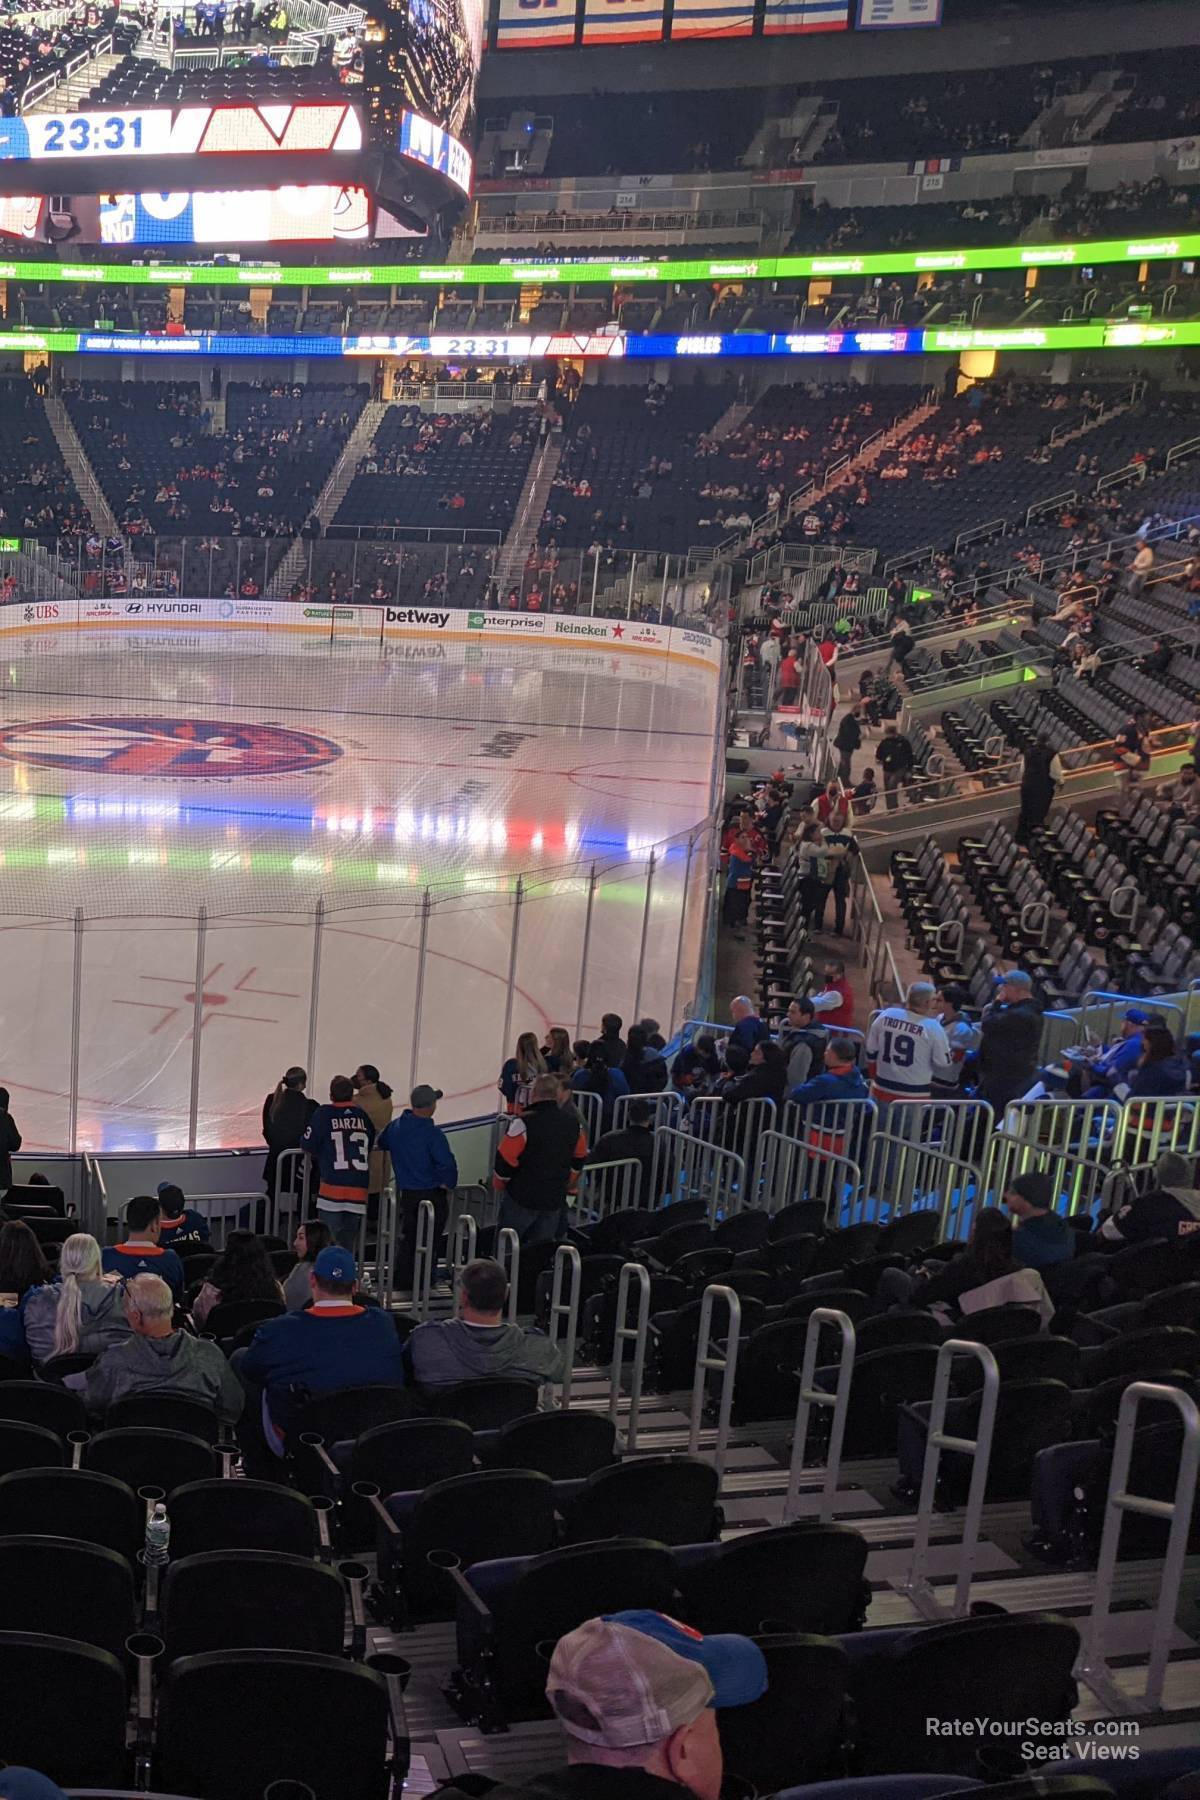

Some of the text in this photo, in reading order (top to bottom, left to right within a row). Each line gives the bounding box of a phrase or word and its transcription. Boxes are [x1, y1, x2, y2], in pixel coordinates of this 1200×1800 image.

[44, 116, 142, 151] 23:31
[447, 339, 509, 354] 23:31
[35, 604, 59, 619] UBS
[147, 603, 201, 613] HYUNDAI
[386, 608, 450, 628] betway
[473, 614, 543, 628] enterprise
[555, 622, 607, 637] Heineken
[883, 1015, 925, 1037] TROTTIER
[881, 1030, 916, 1068] 19
[331, 1117, 367, 1131] BARZAL
[330, 1130, 369, 1171] 13
